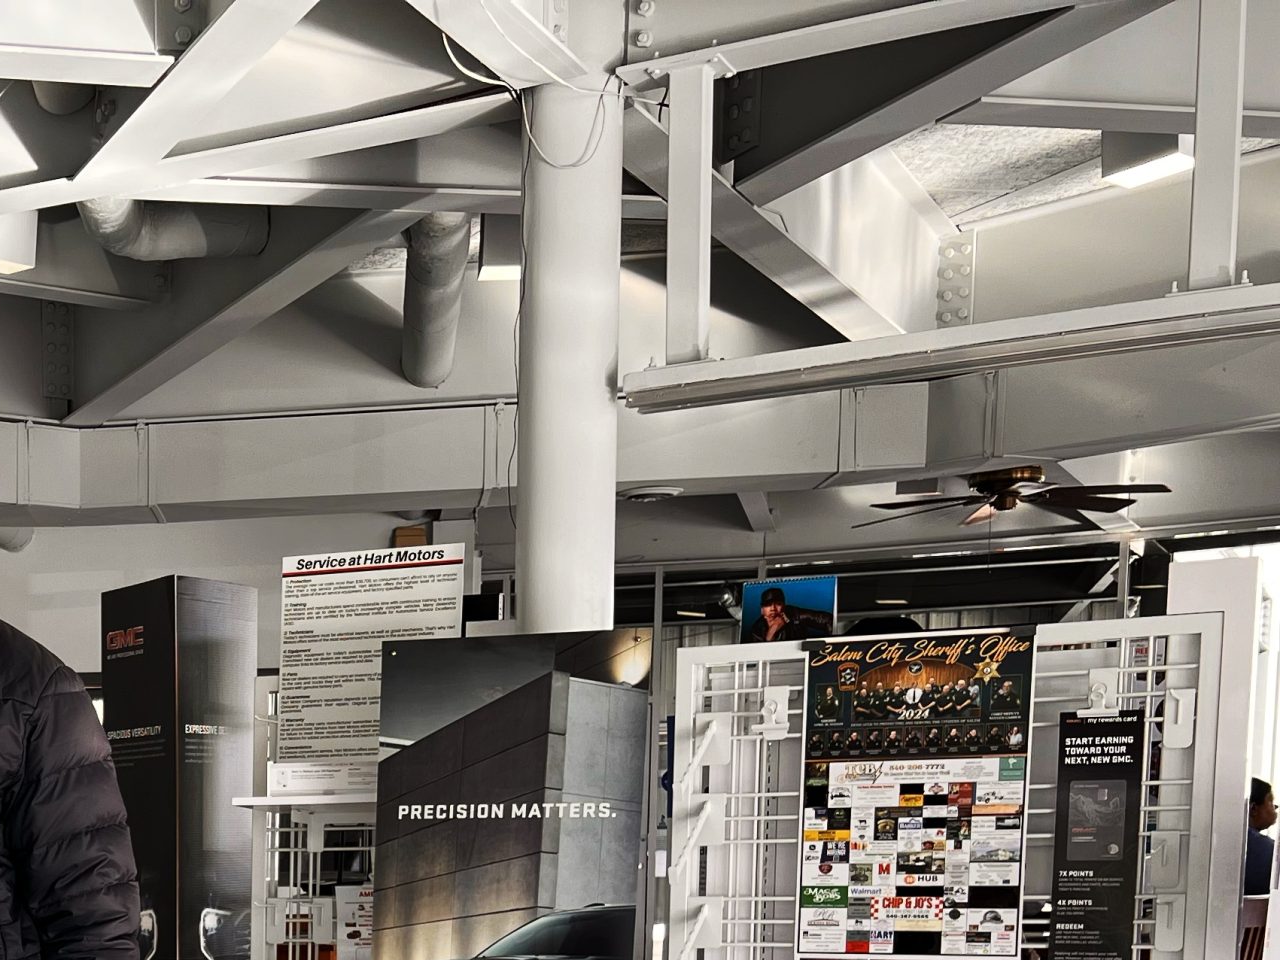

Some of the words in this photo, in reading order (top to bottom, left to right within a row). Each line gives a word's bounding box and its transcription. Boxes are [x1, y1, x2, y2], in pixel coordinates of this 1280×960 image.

[296, 556, 346, 571] Service
[348, 554, 361, 567] at
[363, 552, 394, 566] Hart
[395, 550, 444, 562] Motors
[106, 625, 144, 651] GMC
[811, 645, 864, 667] Salem
[866, 641, 906, 666] City
[905, 637, 977, 665] Sheriff's
[979, 635, 1031, 662] Office
[897, 707, 931, 720] 2024
[107, 729, 131, 741] SPACIOUS
[131, 725, 162, 739] VERSATILITY
[185, 724, 218, 735] EXPRESSIVE
[1065, 737, 1093, 746] START
[1095, 736, 1134, 744] EARNING
[1065, 747, 1101, 755] TOWARD
[1103, 746, 1126, 754] YOUR
[1065, 756, 1089, 765] NEXT,
[1112, 755, 1133, 763] GMC.
[845, 763, 877, 775] TCB
[398, 803, 504, 820] PRECISION
[511, 802, 617, 819] MATTERS.
[878, 863, 891, 875] M
[882, 897, 903, 909] CHIP
[905, 897, 912, 909] &
[913, 897, 933, 909] JO'S
[870, 930, 894, 939] HART
